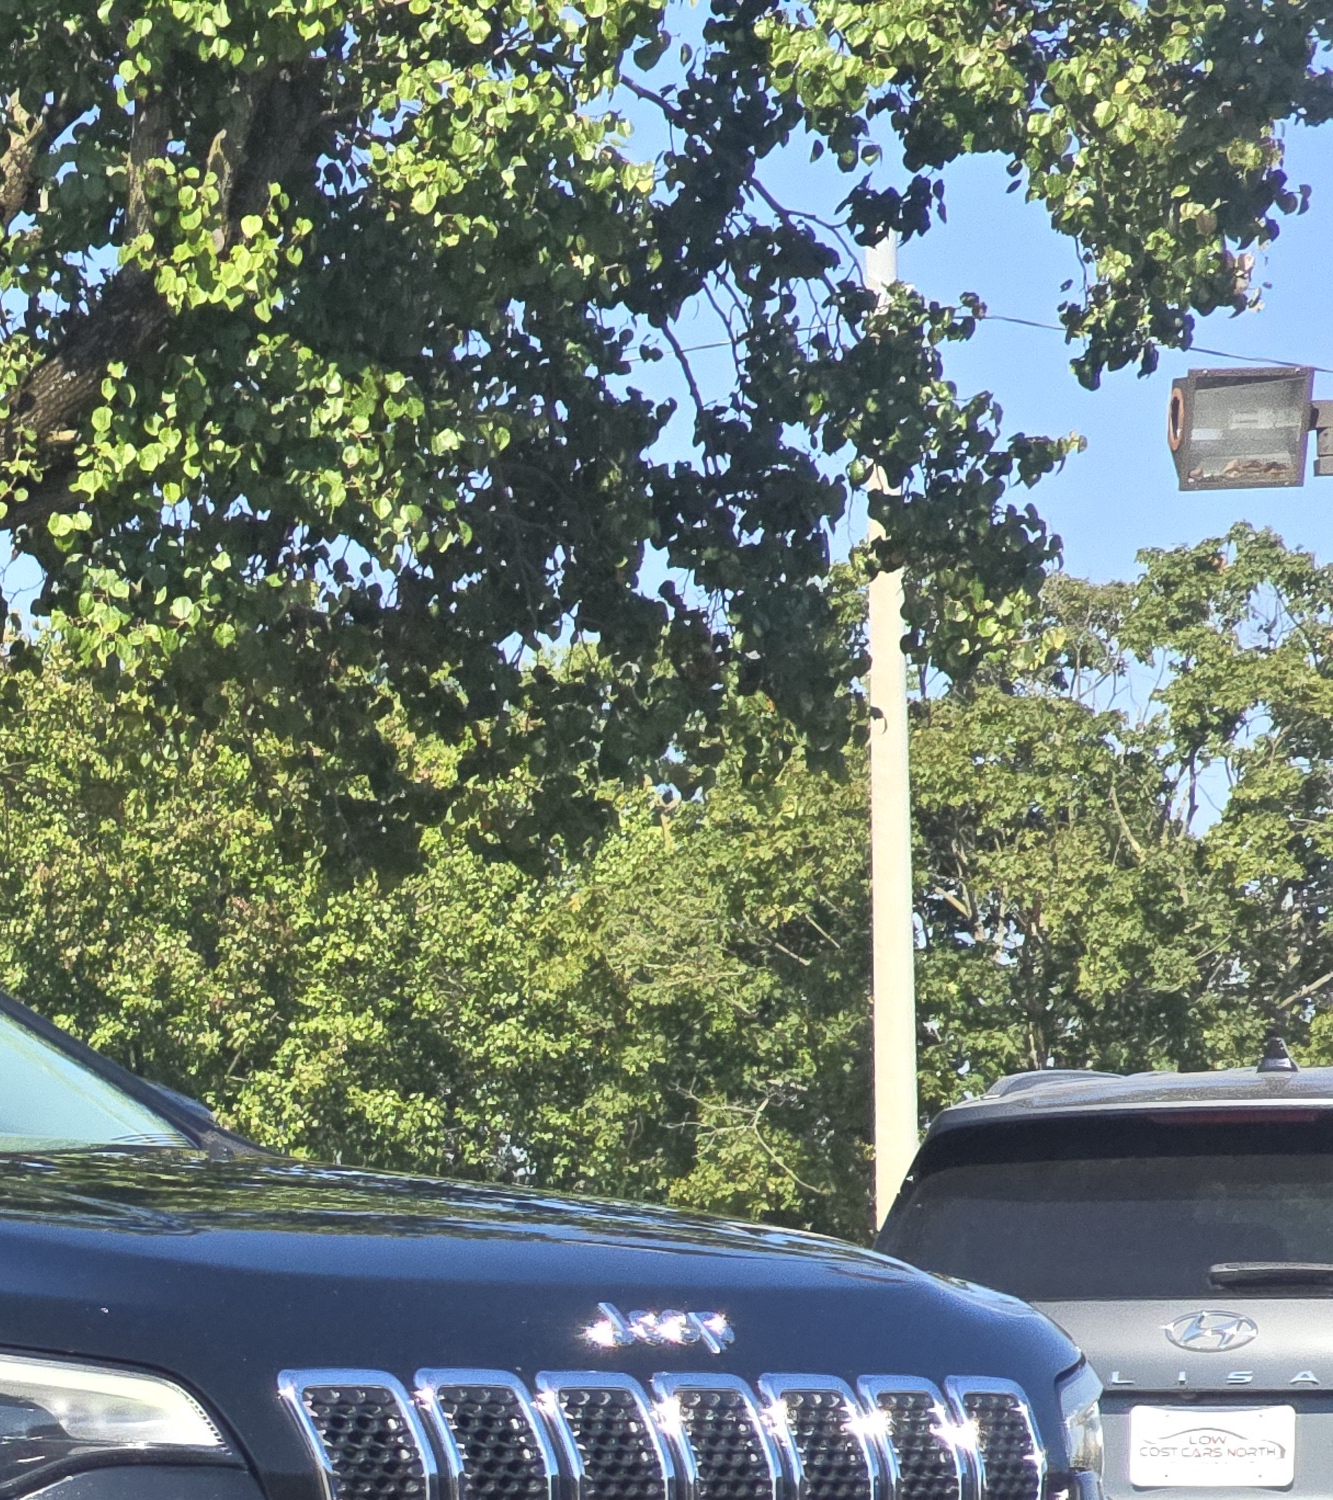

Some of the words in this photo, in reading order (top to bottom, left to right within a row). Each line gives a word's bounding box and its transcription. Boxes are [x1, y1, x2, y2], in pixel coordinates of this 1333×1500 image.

[1188, 1435, 1227, 1446] LOW
[1139, 1447, 1178, 1457] COST
[1181, 1447, 1223, 1458] CARS
[1227, 1446, 1276, 1458] NORTH
